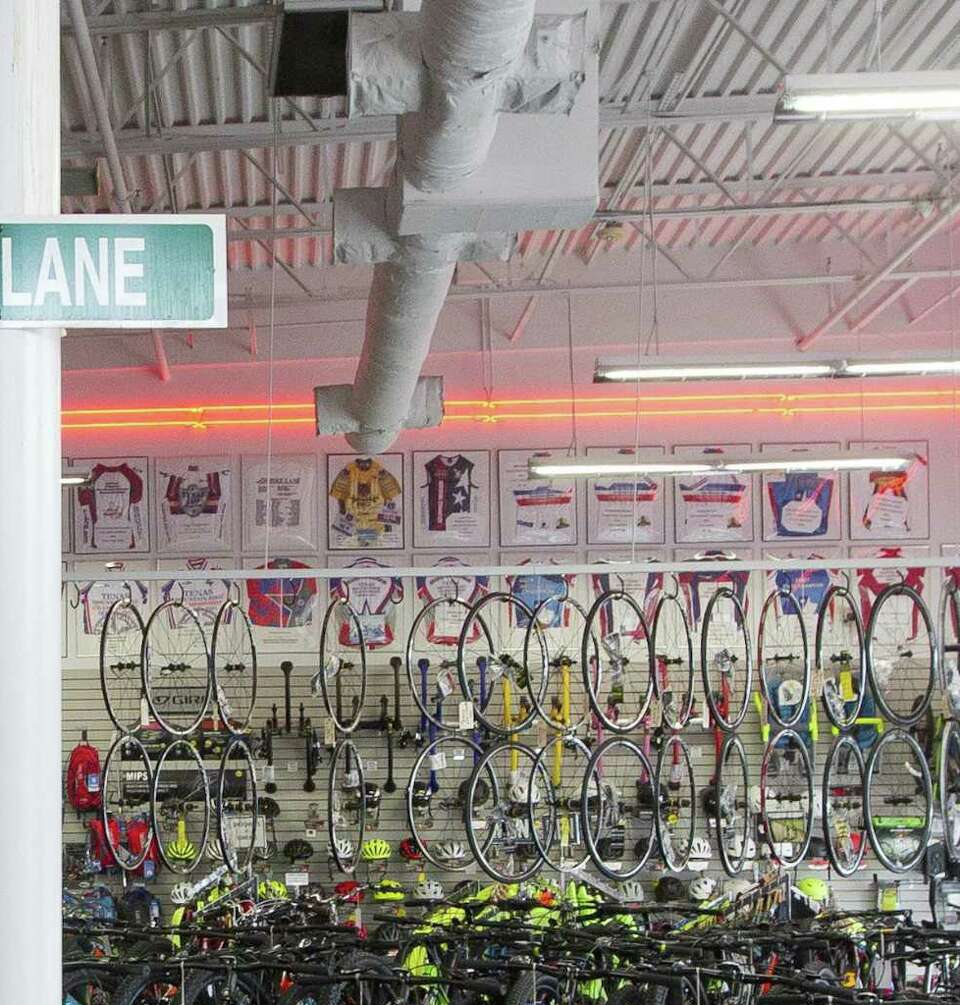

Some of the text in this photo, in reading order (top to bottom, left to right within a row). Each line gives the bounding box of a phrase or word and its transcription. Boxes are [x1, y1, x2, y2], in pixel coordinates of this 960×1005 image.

[1, 237, 147, 308] LANE
[172, 695, 206, 705] GIR
[126, 771, 149, 781] MIPS
